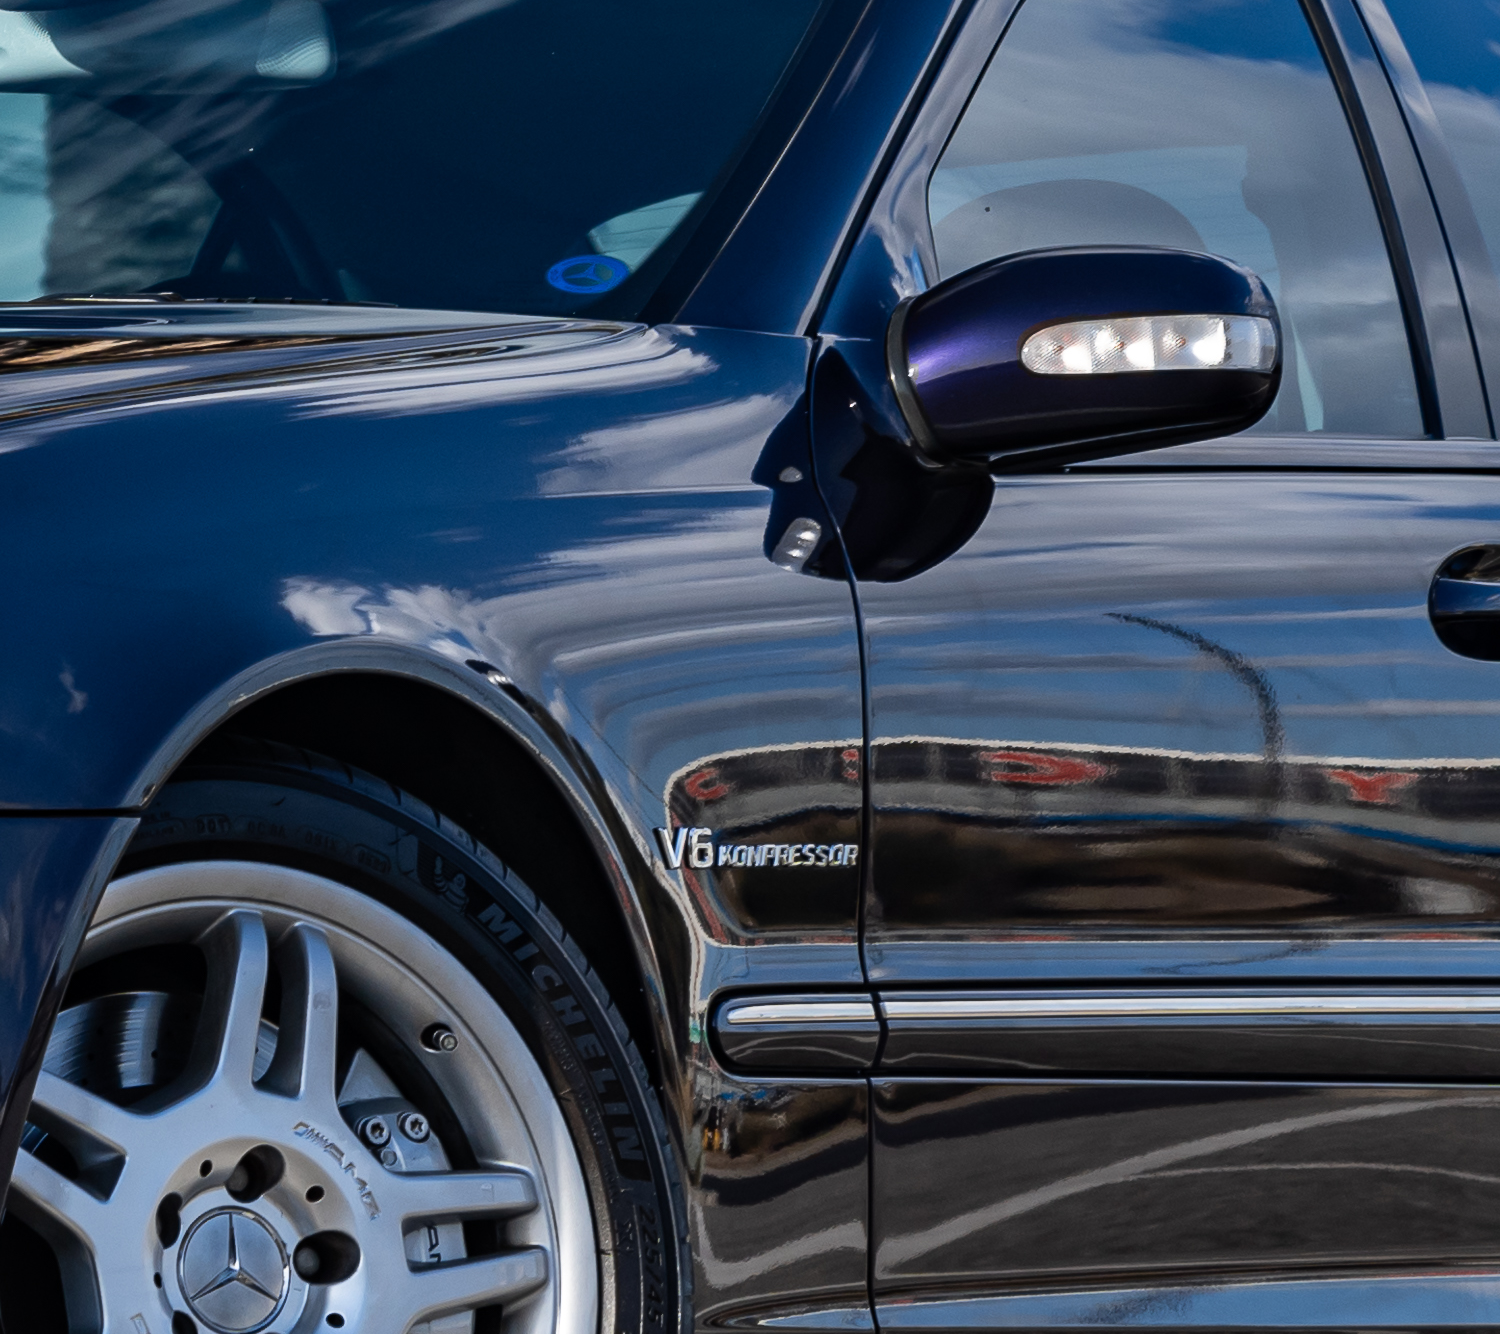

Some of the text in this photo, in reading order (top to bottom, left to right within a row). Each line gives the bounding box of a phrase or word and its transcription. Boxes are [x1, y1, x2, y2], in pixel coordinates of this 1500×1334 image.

[655, 827, 859, 869] V6 KOMPRESSOR
[478, 903, 645, 1161] MICHELIN
